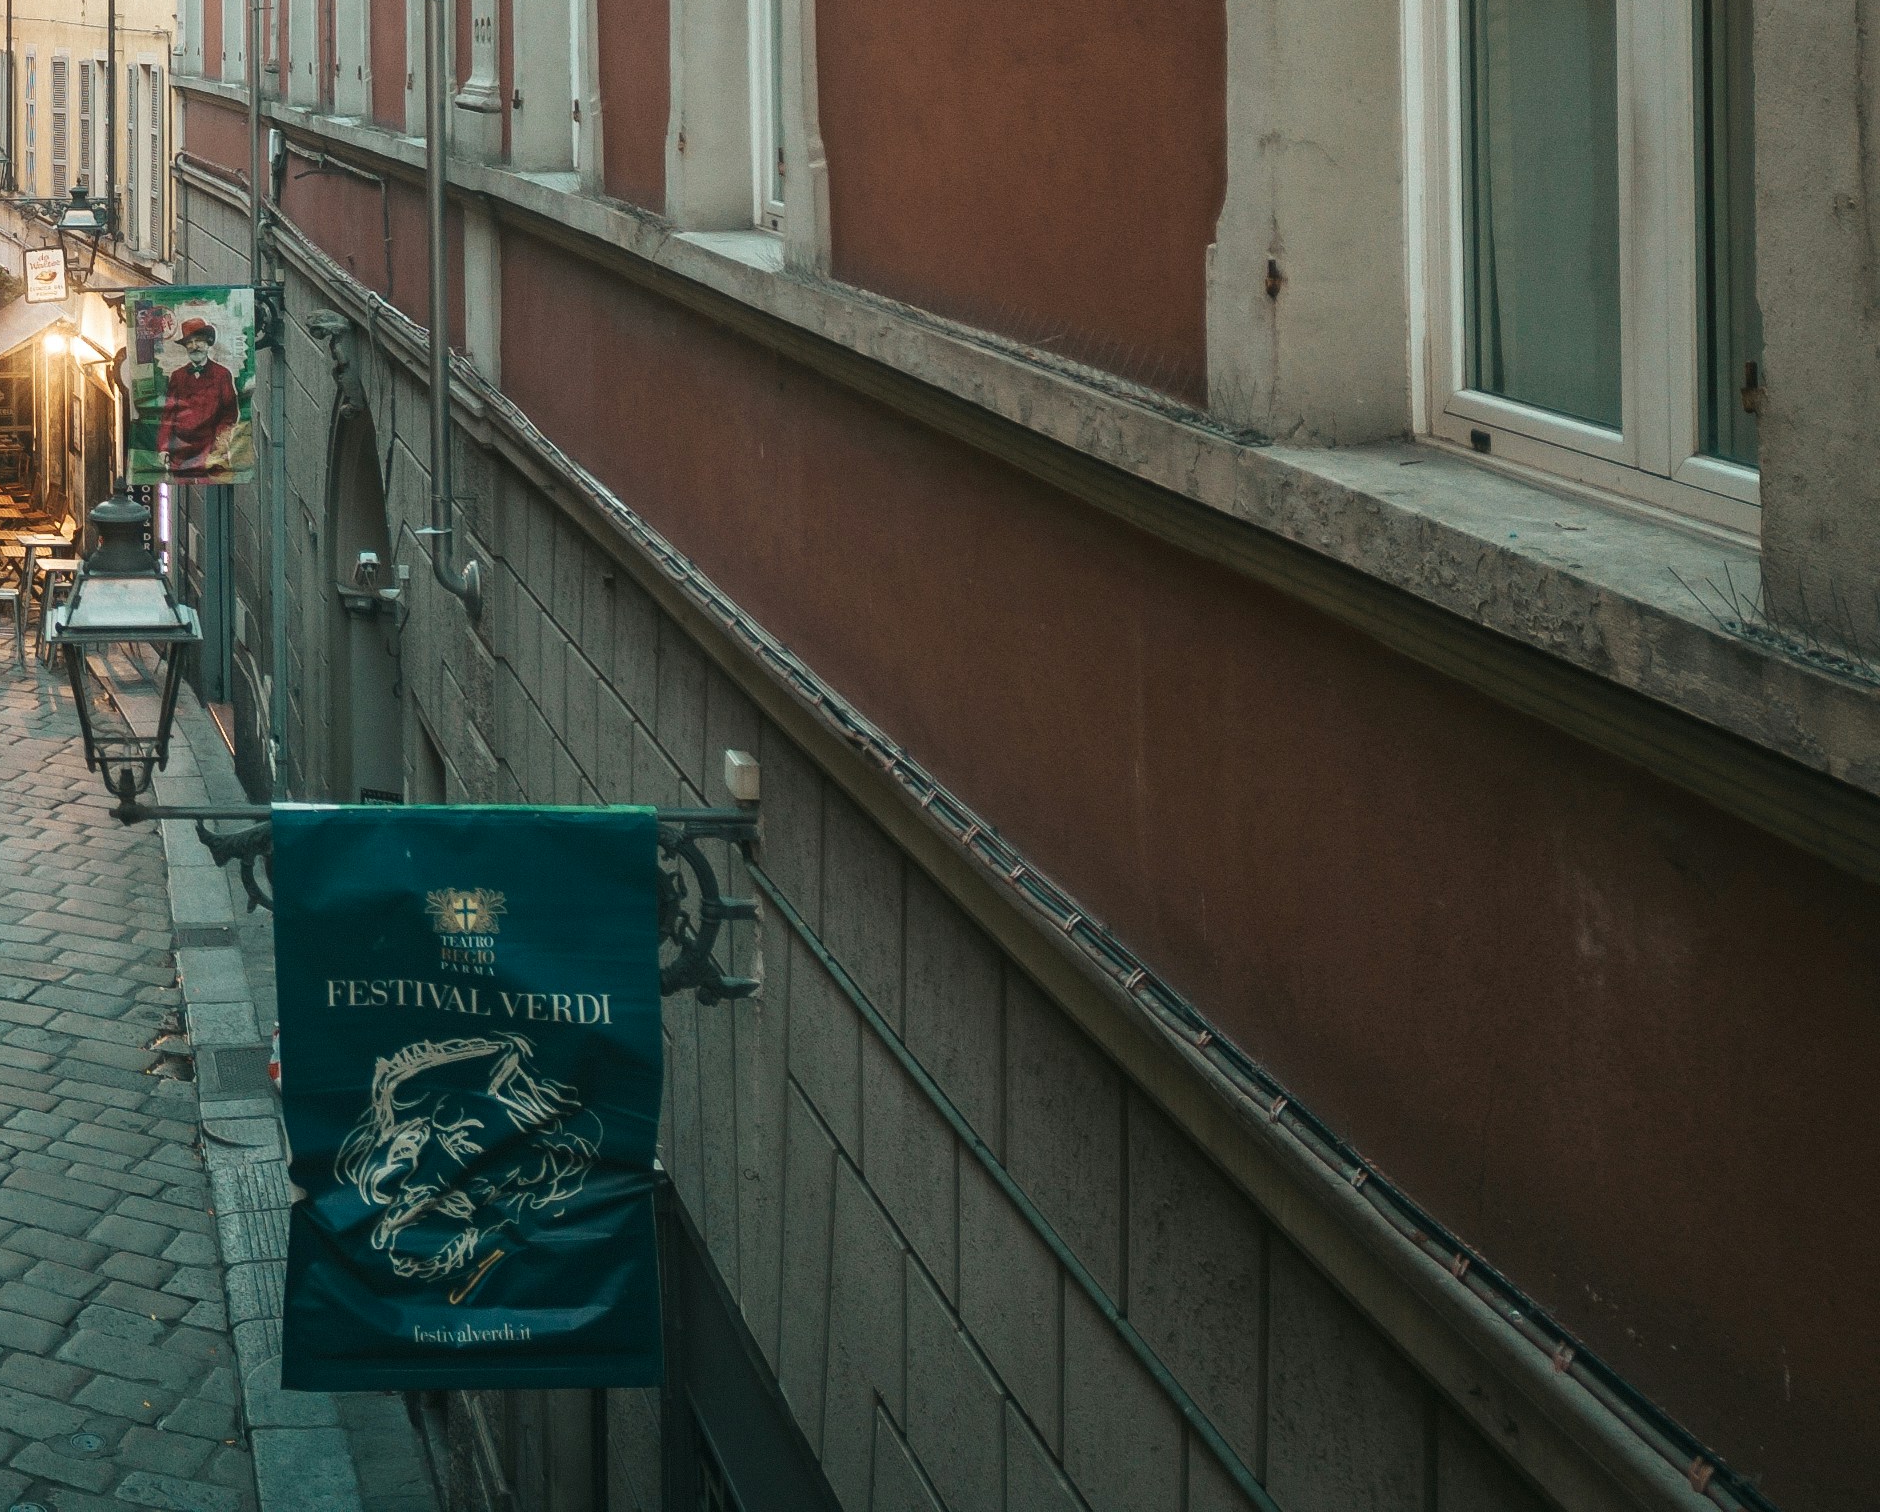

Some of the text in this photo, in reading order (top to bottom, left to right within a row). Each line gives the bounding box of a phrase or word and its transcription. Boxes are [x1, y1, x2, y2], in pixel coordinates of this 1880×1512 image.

[441, 935, 495, 948] TEATRO
[441, 948, 495, 964] REGIO
[441, 961, 496, 977] PARMA
[326, 979, 613, 1025] FESTIVAL VERDI
[414, 1322, 532, 1343] festivalverdi.it
